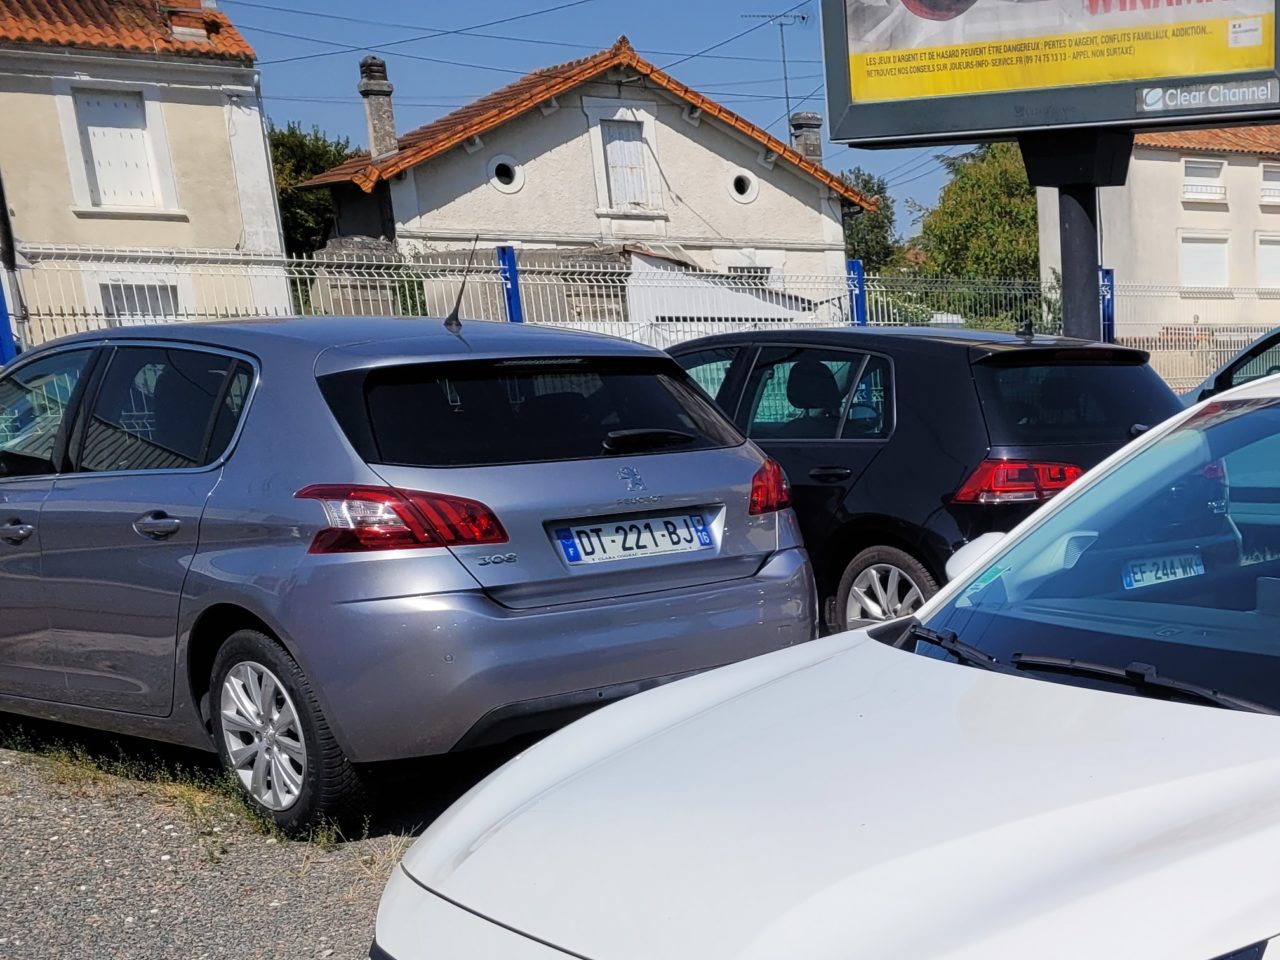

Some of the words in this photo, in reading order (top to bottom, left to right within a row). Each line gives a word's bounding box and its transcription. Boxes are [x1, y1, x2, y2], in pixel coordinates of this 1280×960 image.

[865, 57, 877, 66] LES
[877, 55, 891, 65] JEUX
[919, 52, 927, 61] ET
[928, 51, 935, 60] DE
[936, 49, 960, 58] HASARD
[960, 46, 987, 57] PEUVENT
[1003, 42, 1040, 54] DANGEREUX
[1043, 39, 1066, 50] PERTES
[1101, 33, 1131, 44] CONFLITS
[866, 66, 897, 78] RETROUVEZ
[897, 66, 909, 76] NOS
[909, 64, 936, 74] CONSEILS
[936, 63, 948, 72] SUR
[1050, 53, 1058, 62] 13
[1059, 52, 1067, 61] 13
[1072, 50, 1090, 60] APPEL
[1091, 49, 1105, 58] NON
[1165, 88, 1205, 106] Clear
[1208, 82, 1271, 103] Channel
[575, 518, 695, 556] DT-221-BJ
[697, 530, 711, 545] 16
[477, 552, 518, 566] 308
[1131, 557, 1197, 583] EF-244-WK
